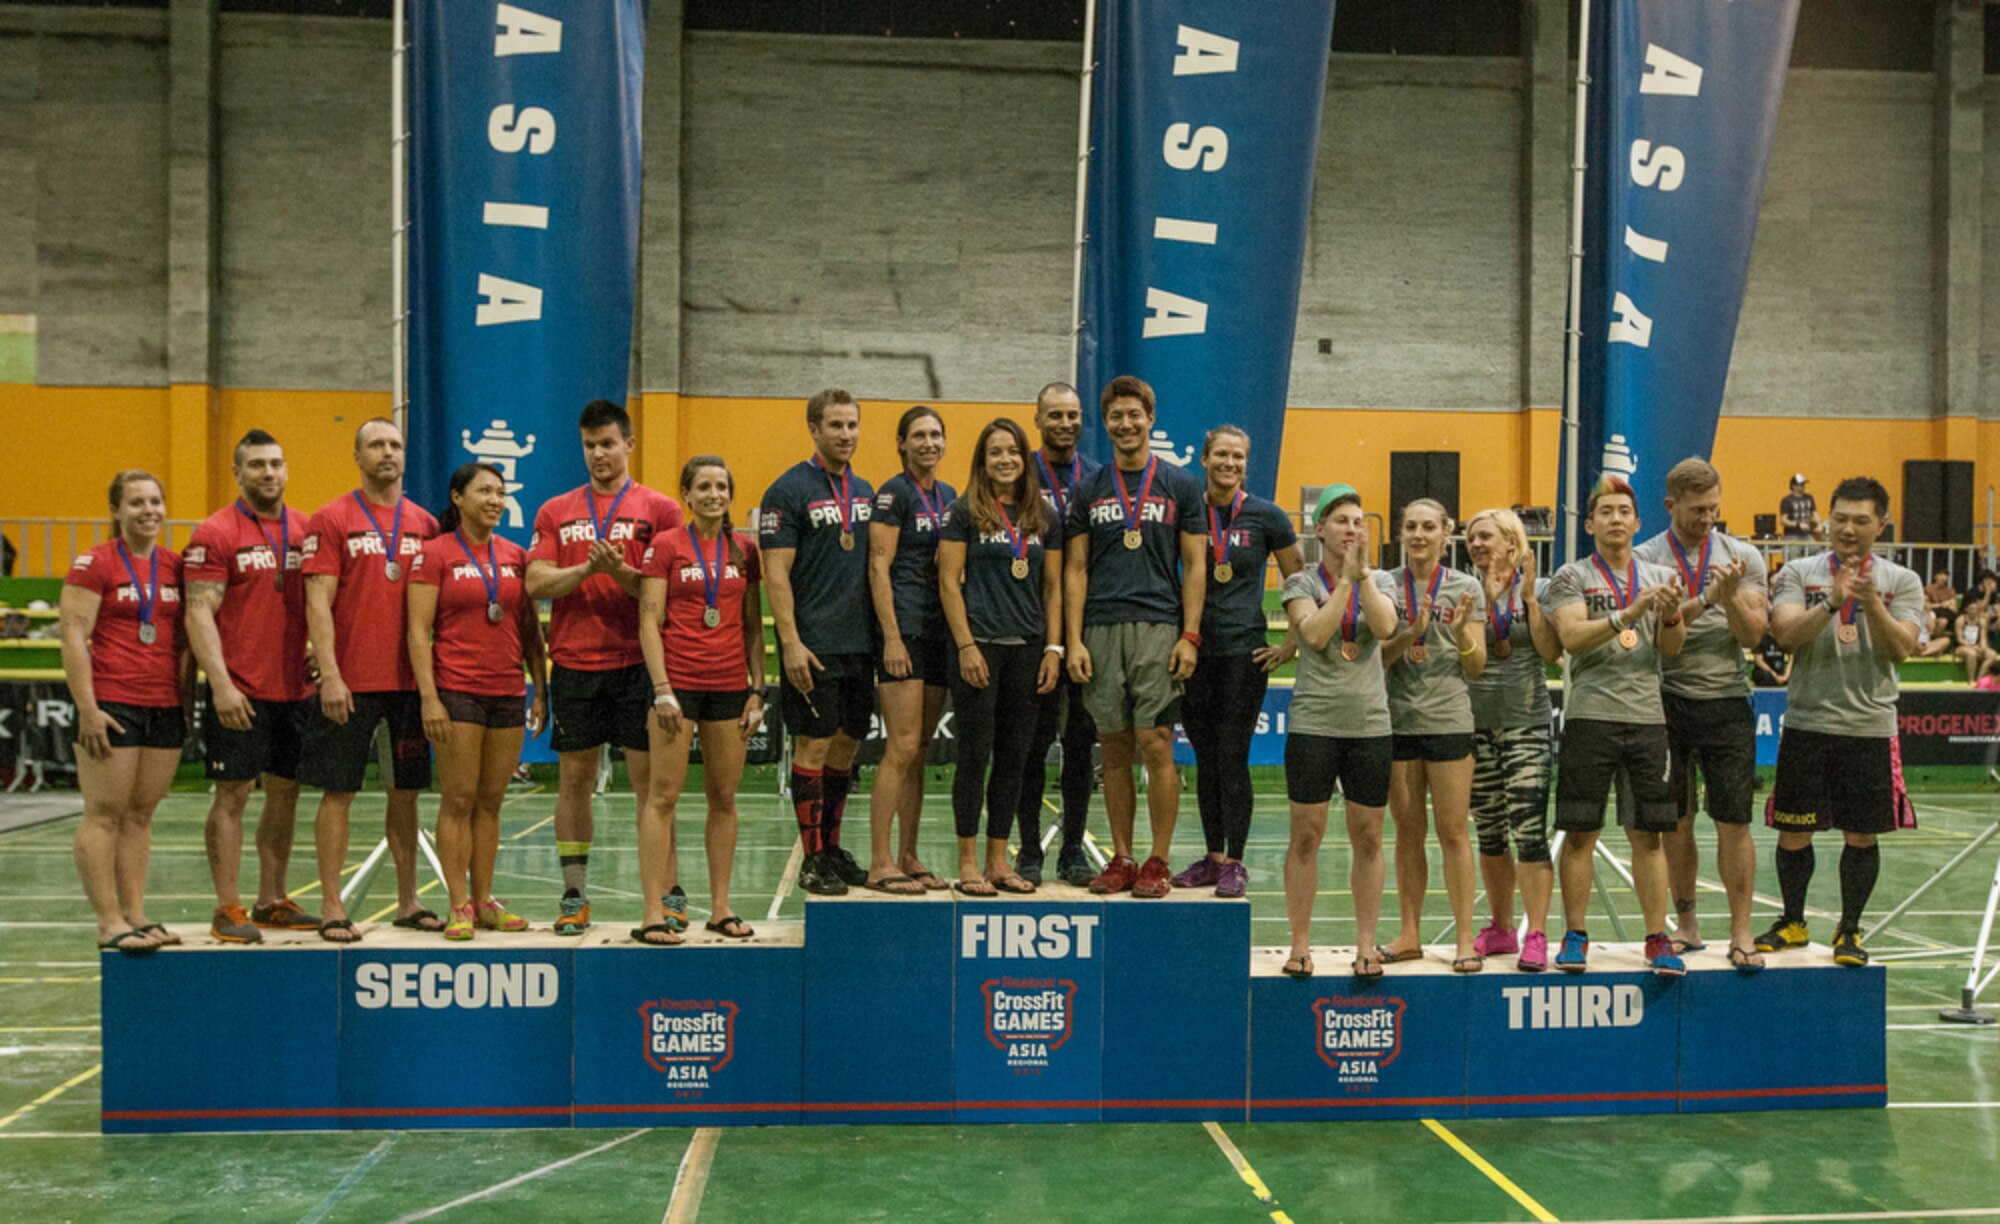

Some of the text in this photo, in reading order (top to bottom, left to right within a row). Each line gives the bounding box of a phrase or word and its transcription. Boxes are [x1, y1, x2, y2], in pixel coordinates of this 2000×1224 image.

[476, 3, 562, 326] ASIA
[1142, 24, 1240, 339] ASIA
[1608, 43, 1703, 348] ASIA
[1089, 502, 1165, 527] PROEN
[560, 522, 634, 546] PROEN
[347, 537, 422, 558] PROEN
[236, 551, 302, 573] PROE
[681, 565, 740, 583] PREN
[117, 586, 180, 602] PREN
[961, 914, 1099, 959] FIRST
[355, 962, 559, 1009] SECOND
[993, 990, 1065, 1011] CrossFit
[1501, 984, 1644, 1029] THIRD
[652, 1012, 726, 1033] CrossFit
[993, 1011, 1065, 1031] GAMES
[1325, 1009, 1394, 1029] CrossFit
[652, 1033, 726, 1053] GAMES
[1008, 1043, 1048, 1057] ASIA
[1324, 1030, 1394, 1049] GAMES
[667, 1065, 709, 1080] ASIA
[1338, 1061, 1378, 1075] ASIA
